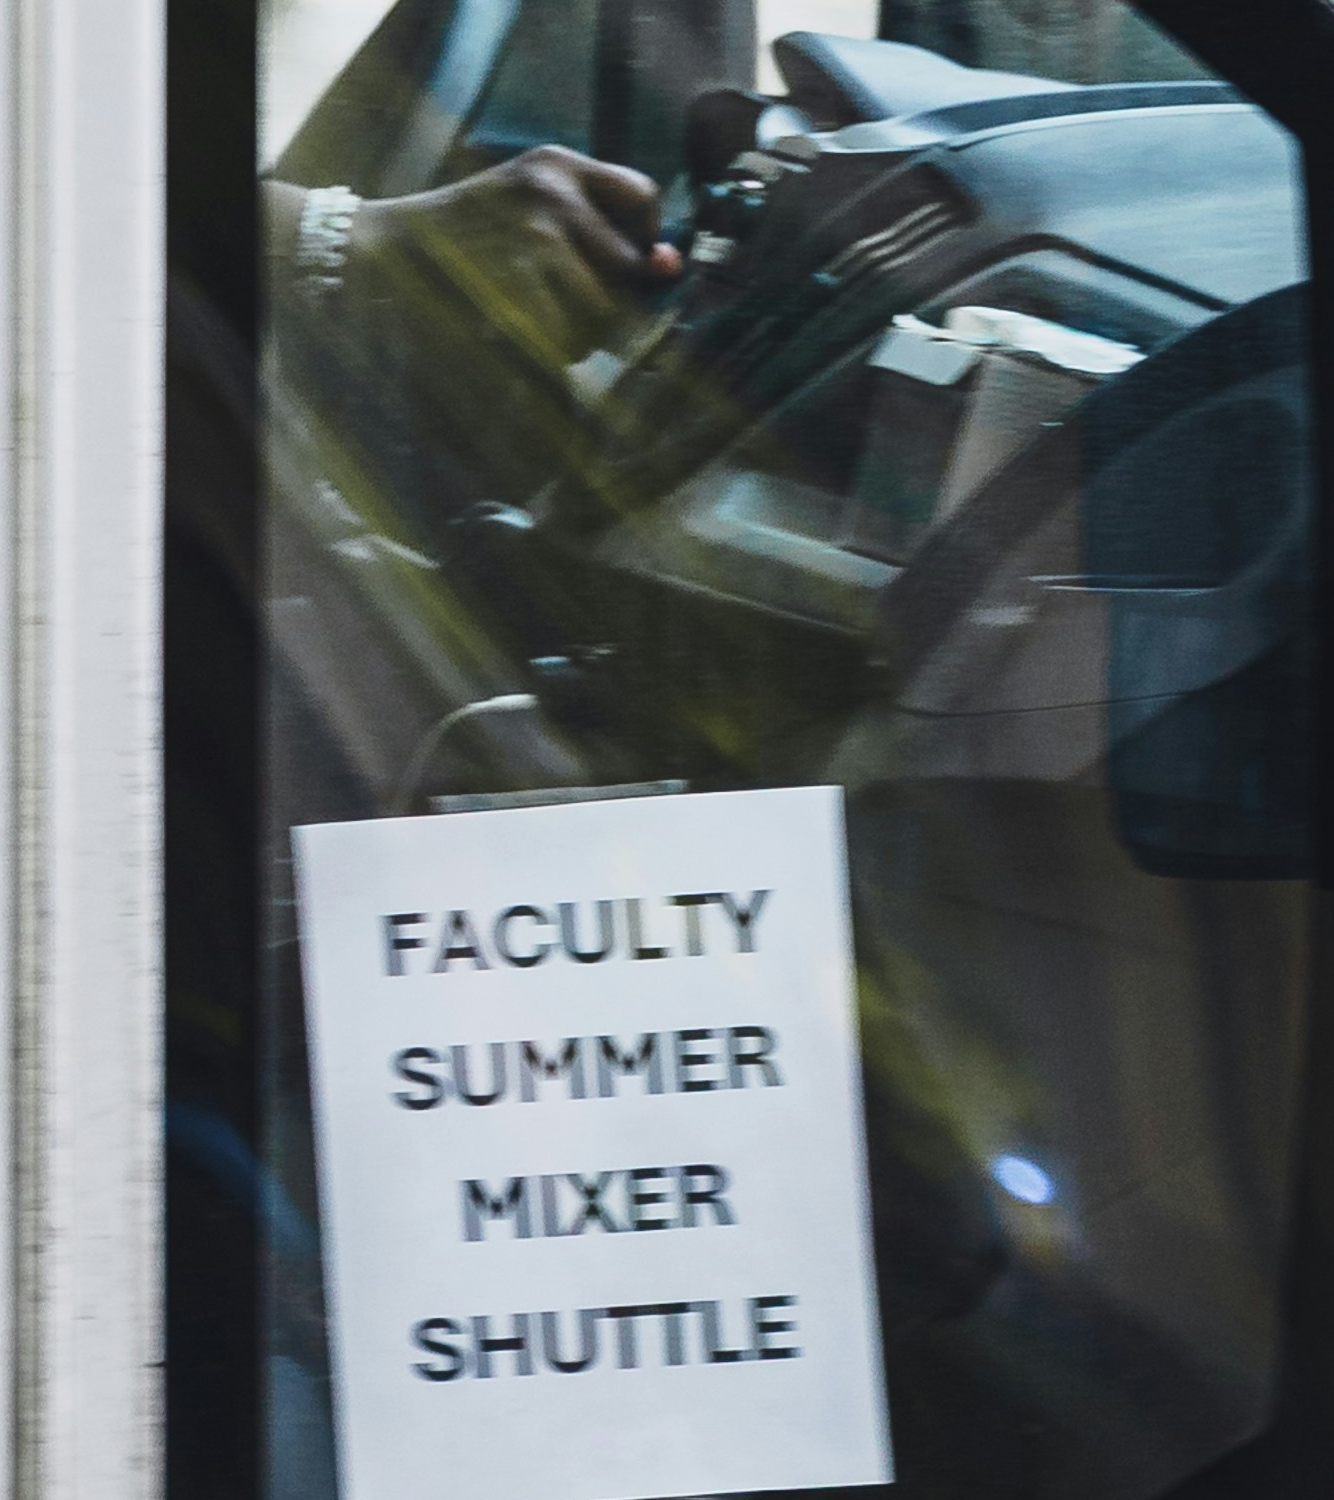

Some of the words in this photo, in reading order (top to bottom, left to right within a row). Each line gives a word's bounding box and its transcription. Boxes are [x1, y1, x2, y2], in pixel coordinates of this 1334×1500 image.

[377, 887, 775, 978] FACULTY
[388, 1023, 789, 1112] SUMMER
[457, 1162, 741, 1244] MIXER
[408, 1293, 804, 1384] SHUTTLE
